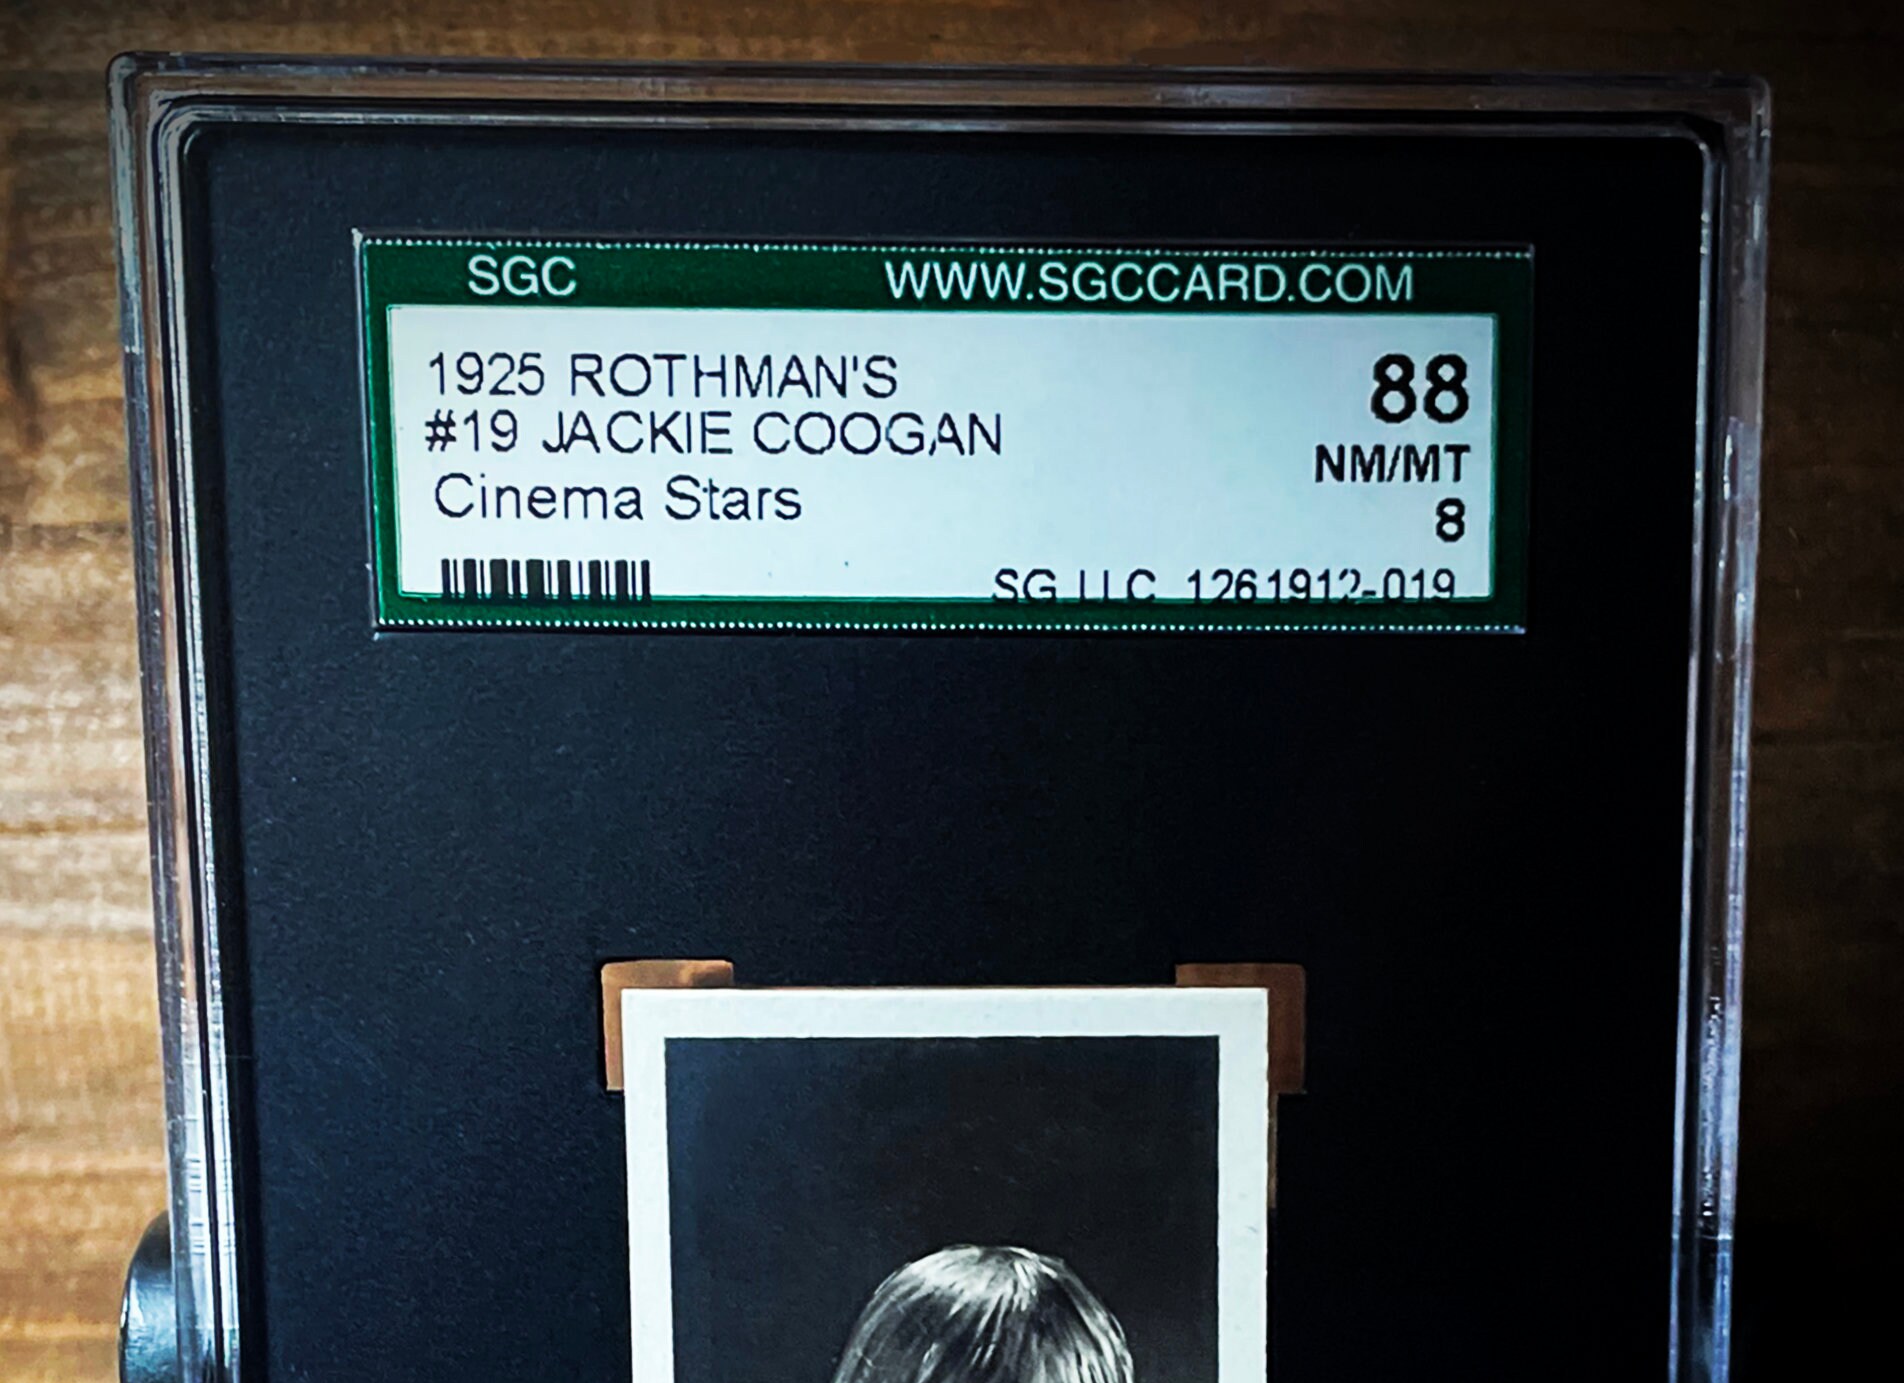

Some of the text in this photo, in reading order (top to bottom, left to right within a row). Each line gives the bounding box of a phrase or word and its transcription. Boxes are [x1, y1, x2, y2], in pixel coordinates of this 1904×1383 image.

[468, 255, 577, 296] SGC
[885, 260, 1414, 302] WWW.SGCCARD.COM
[428, 351, 899, 398] 1925 ROTHMAN'S
[1370, 353, 1469, 424] 88
[424, 408, 1001, 455] #19 JACKIE COOGAN
[1315, 443, 1471, 483] NM/MT
[434, 472, 803, 521] Cinema Stars
[1435, 497, 1466, 542] 8
[993, 568, 1057, 603] SG
[1186, 567, 1457, 602] 1261912-019
